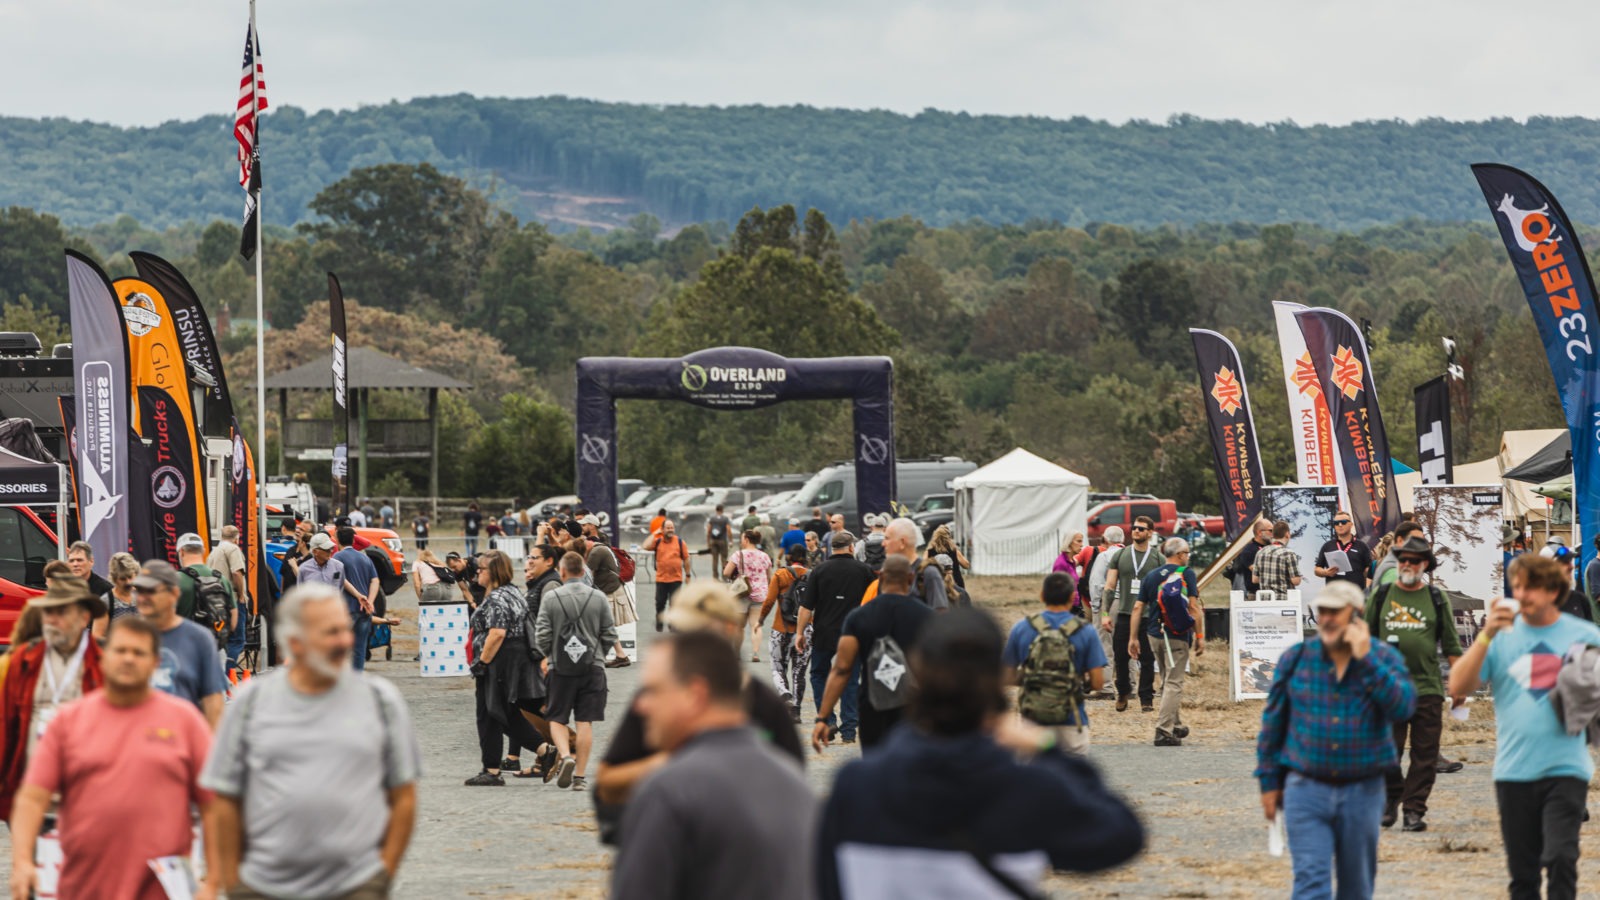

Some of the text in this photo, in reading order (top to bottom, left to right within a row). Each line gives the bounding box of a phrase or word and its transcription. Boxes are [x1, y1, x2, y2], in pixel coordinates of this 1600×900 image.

[1521, 212, 1592, 362] 23ZERO
[175, 309, 205, 370] PRINSU
[190, 305, 206, 341] SYSTEM
[710, 366, 786, 382] OVERLAND
[734, 382, 762, 390] EXPO
[154, 399, 171, 462] Trucks
